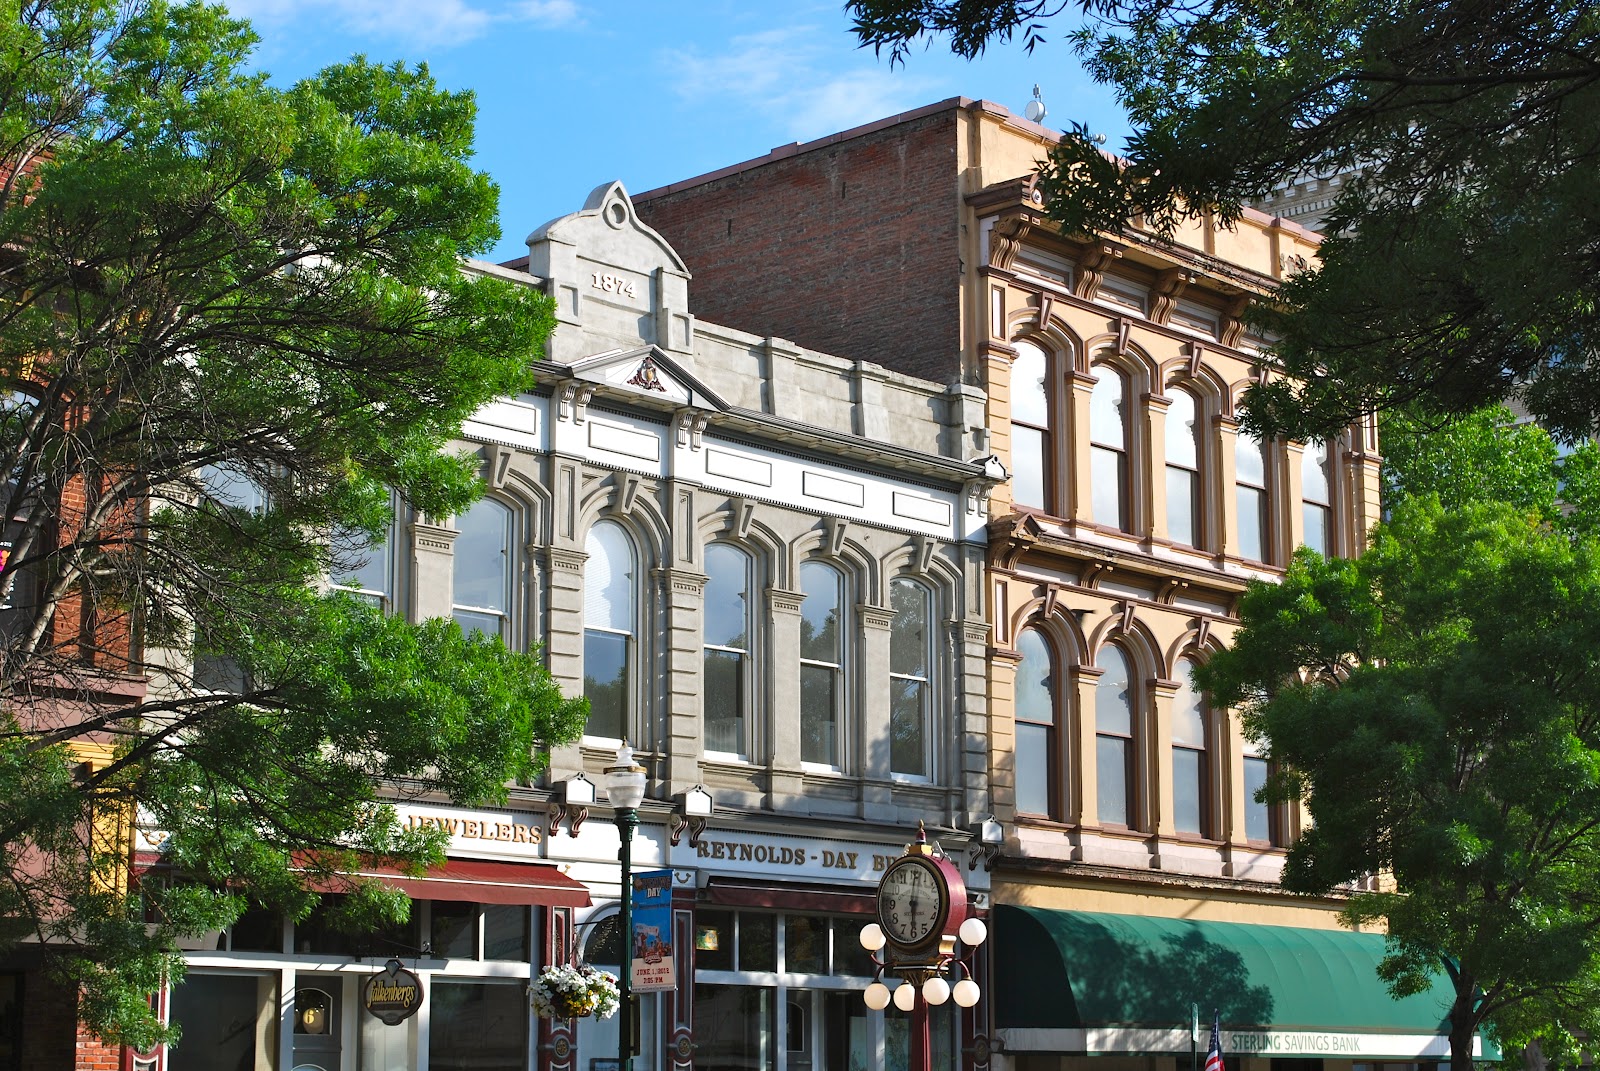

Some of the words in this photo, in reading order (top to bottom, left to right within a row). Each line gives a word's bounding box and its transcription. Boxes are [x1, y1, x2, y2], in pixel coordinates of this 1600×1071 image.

[591, 271, 637, 299] 1874
[403, 815, 542, 844] JEWELERS
[697, 840, 806, 865] REYNOLDS
[822, 850, 859, 869] DAY
[647, 887, 661, 898] DAY
[889, 900, 896, 910] 9
[892, 913, 899, 924] 8
[930, 912, 936, 920] 4
[901, 924, 907, 934] 7
[910, 926, 917, 938] 6
[921, 923, 928, 934] 5
[636, 968, 651, 976] JUNE
[1232, 1034, 1281, 1050] STERLING
[1284, 1034, 1329, 1051] SAVINGS
[1332, 1036, 1361, 1051] BANK
